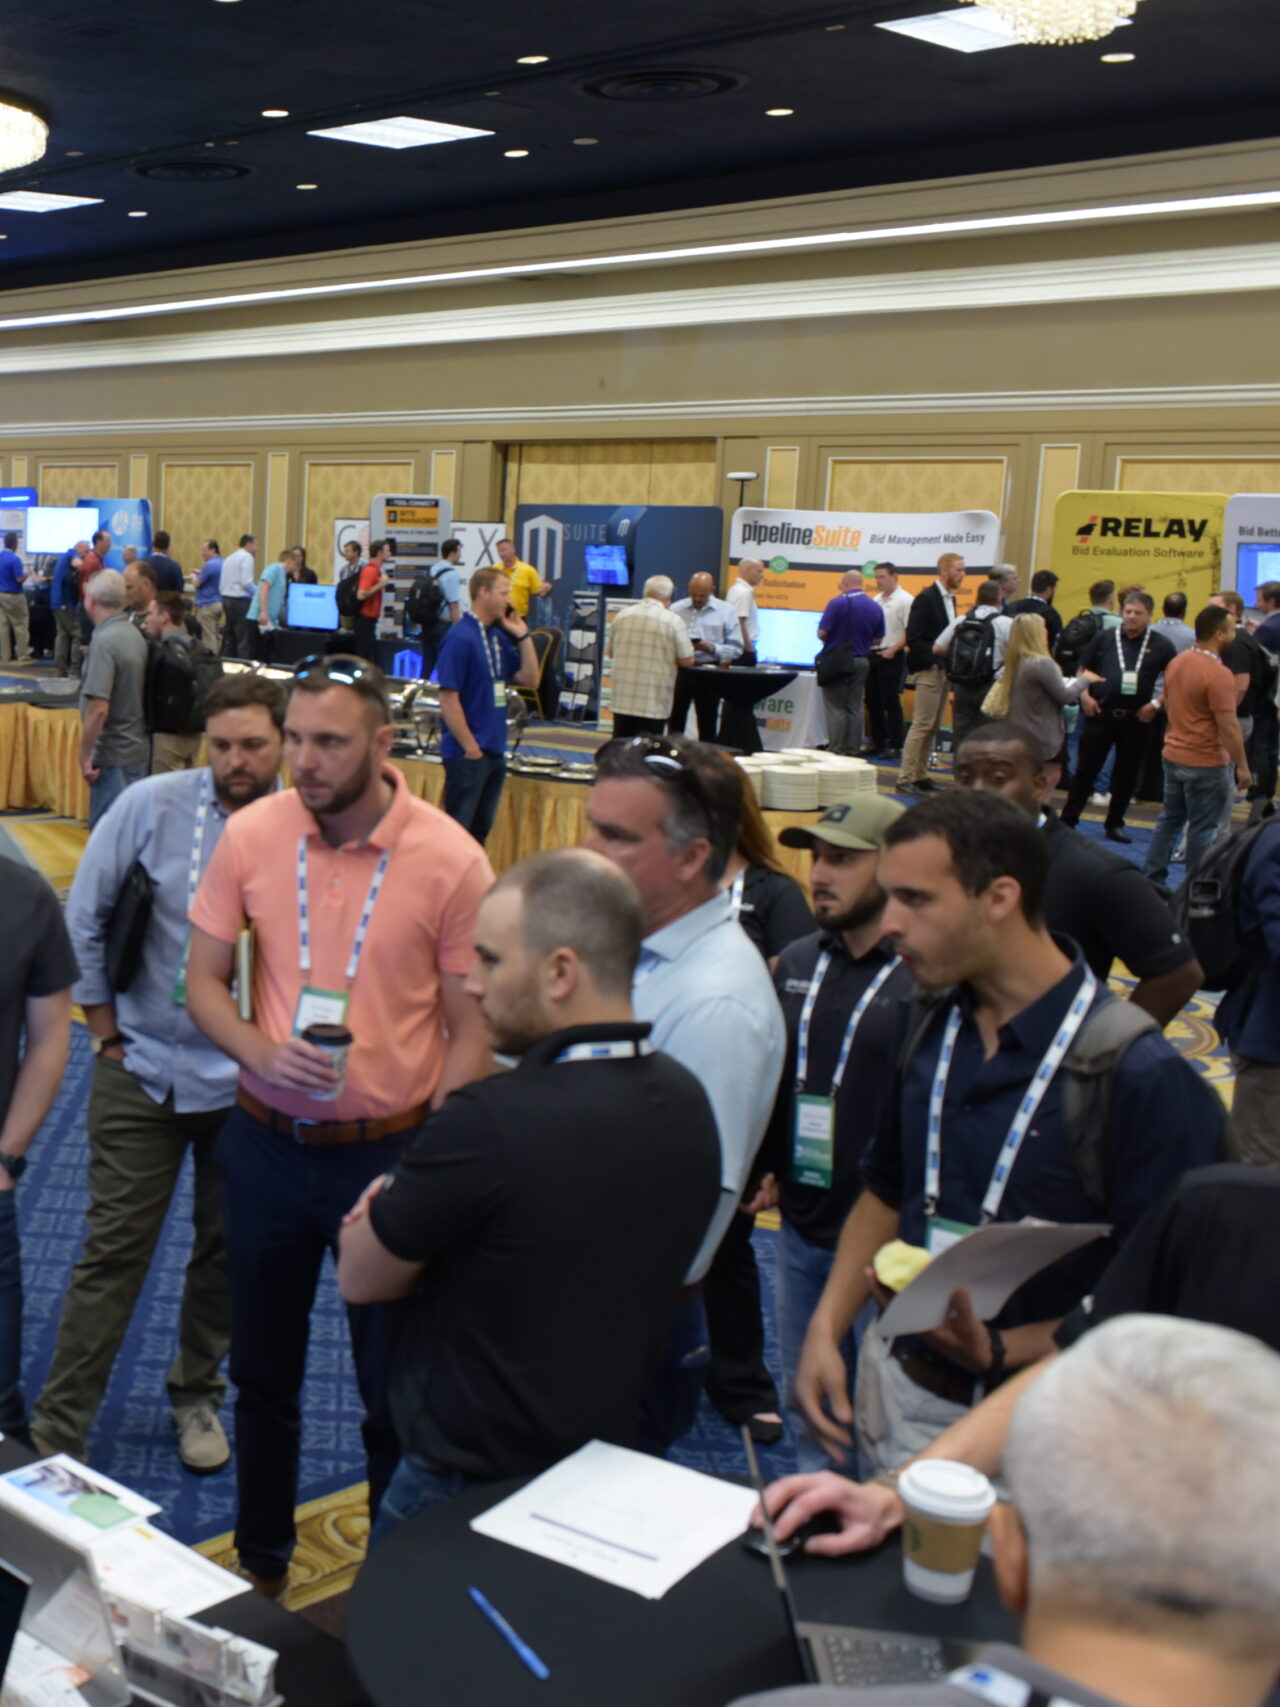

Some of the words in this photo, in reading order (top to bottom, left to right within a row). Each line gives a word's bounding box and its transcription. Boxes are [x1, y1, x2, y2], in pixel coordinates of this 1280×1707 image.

[564, 523, 607, 542] SUITE
[741, 520, 862, 548] pipelineSuite
[1100, 517, 1209, 542] RELAY
[1238, 525, 1255, 536] Bid
[869, 533, 885, 544] Bid
[887, 534, 941, 547] Management
[943, 532, 964, 544] Made
[965, 531, 985, 545] Easy
[1071, 545, 1090, 556] Bid
[1092, 546, 1151, 558] Evaluation
[1153, 547, 1205, 559] Software
